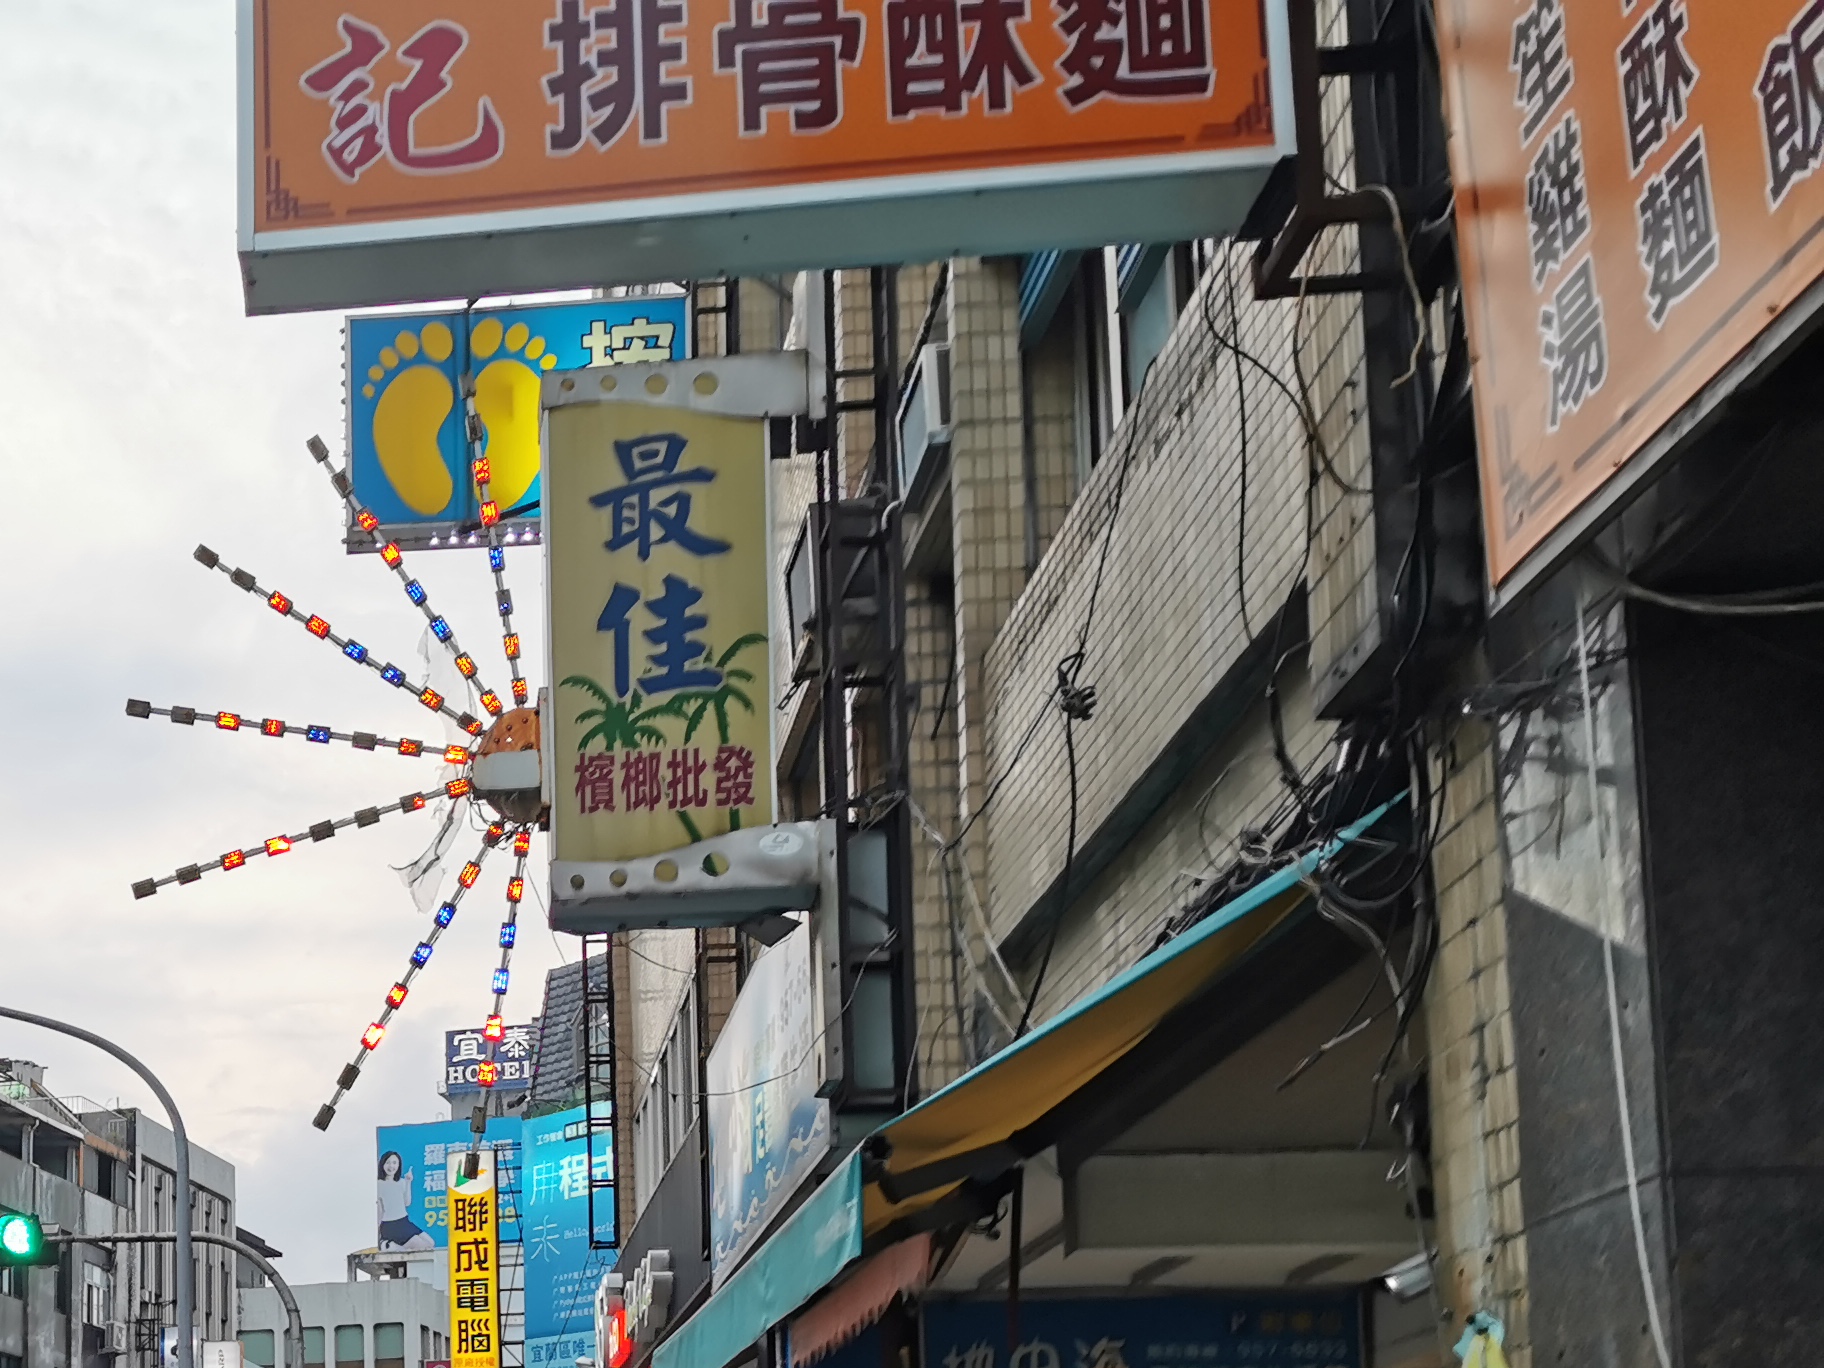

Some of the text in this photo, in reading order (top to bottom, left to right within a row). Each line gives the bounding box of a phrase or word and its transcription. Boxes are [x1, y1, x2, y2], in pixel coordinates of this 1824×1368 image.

[1616, 0, 1720, 331] 酥麵
[590, 433, 733, 699] 最佳
[575, 747, 756, 814] 檳榔批發
[454, 1197, 491, 1354] 聯成電腦
